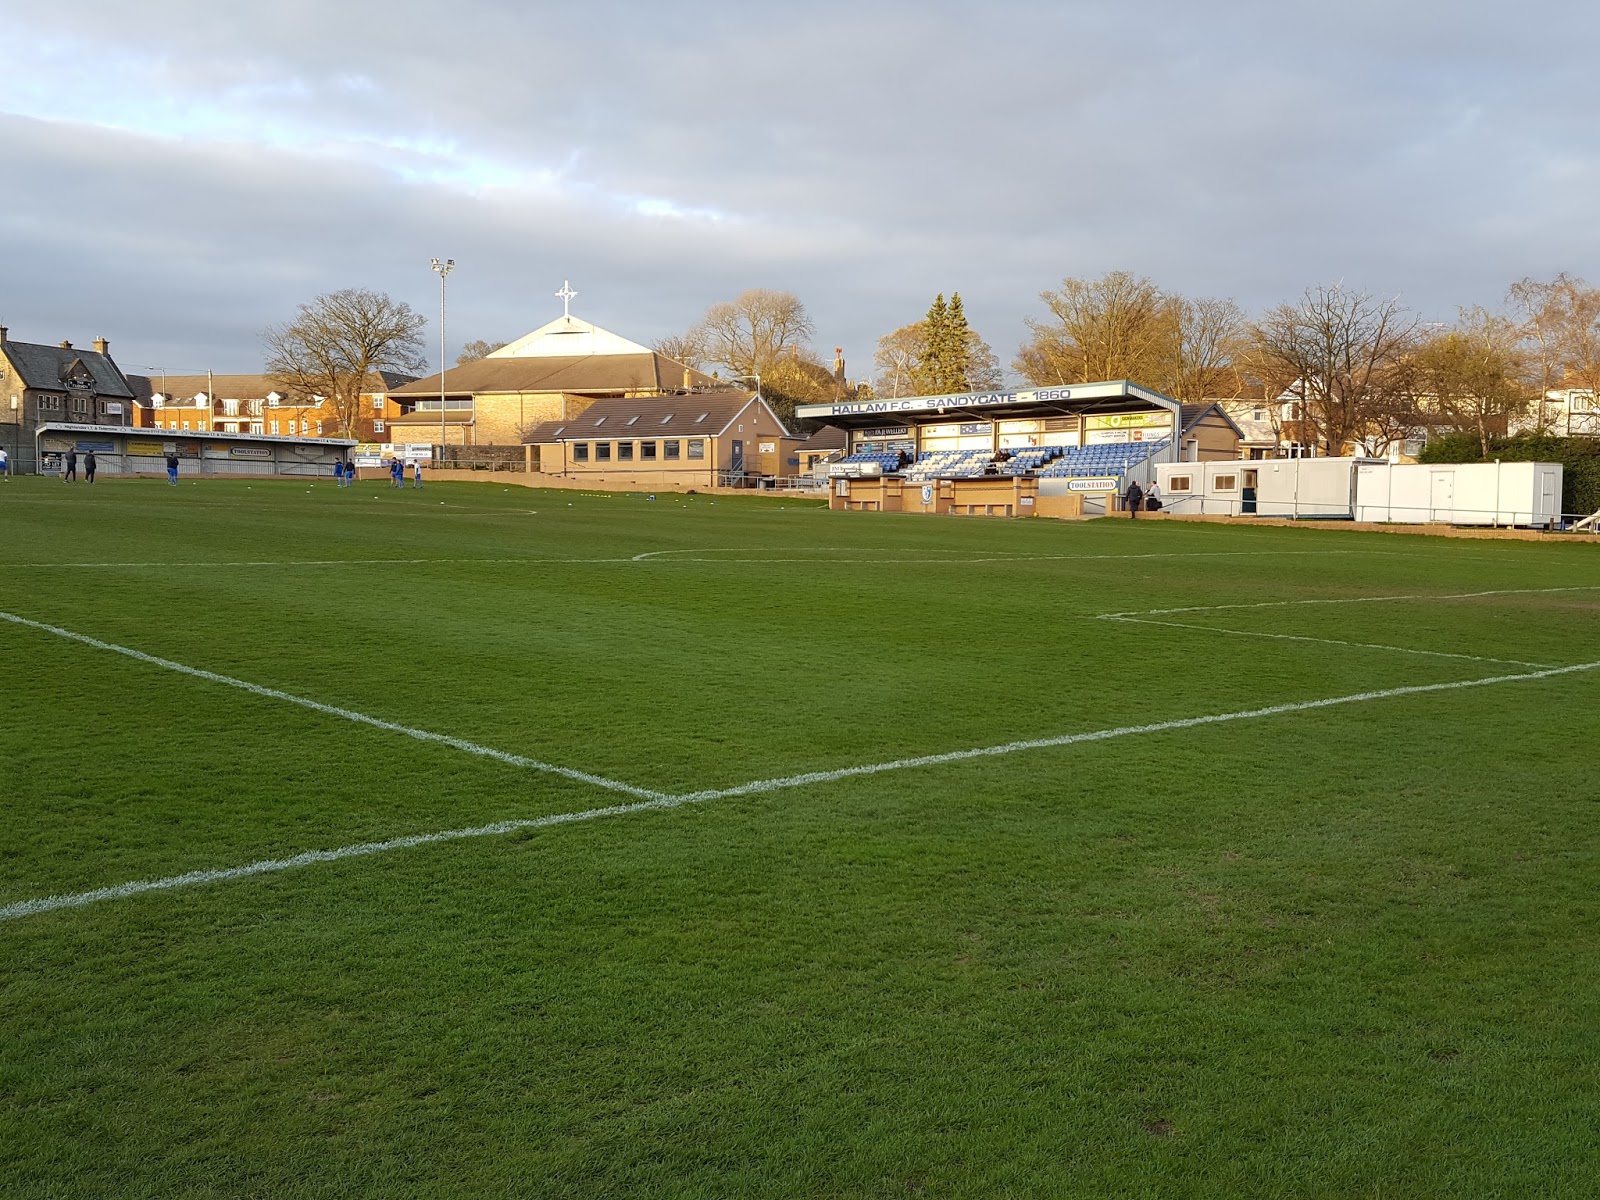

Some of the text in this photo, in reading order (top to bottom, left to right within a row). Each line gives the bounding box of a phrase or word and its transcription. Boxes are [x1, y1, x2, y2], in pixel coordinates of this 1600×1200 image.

[832, 403, 887, 415] HALLAM
[890, 401, 914, 411] F.C.
[926, 393, 1017, 408] SANDYGATE
[1032, 390, 1071, 400] 1860
[881, 428, 907, 436] JEWELLERY
[1071, 481, 1114, 489] TOOLSTATION
